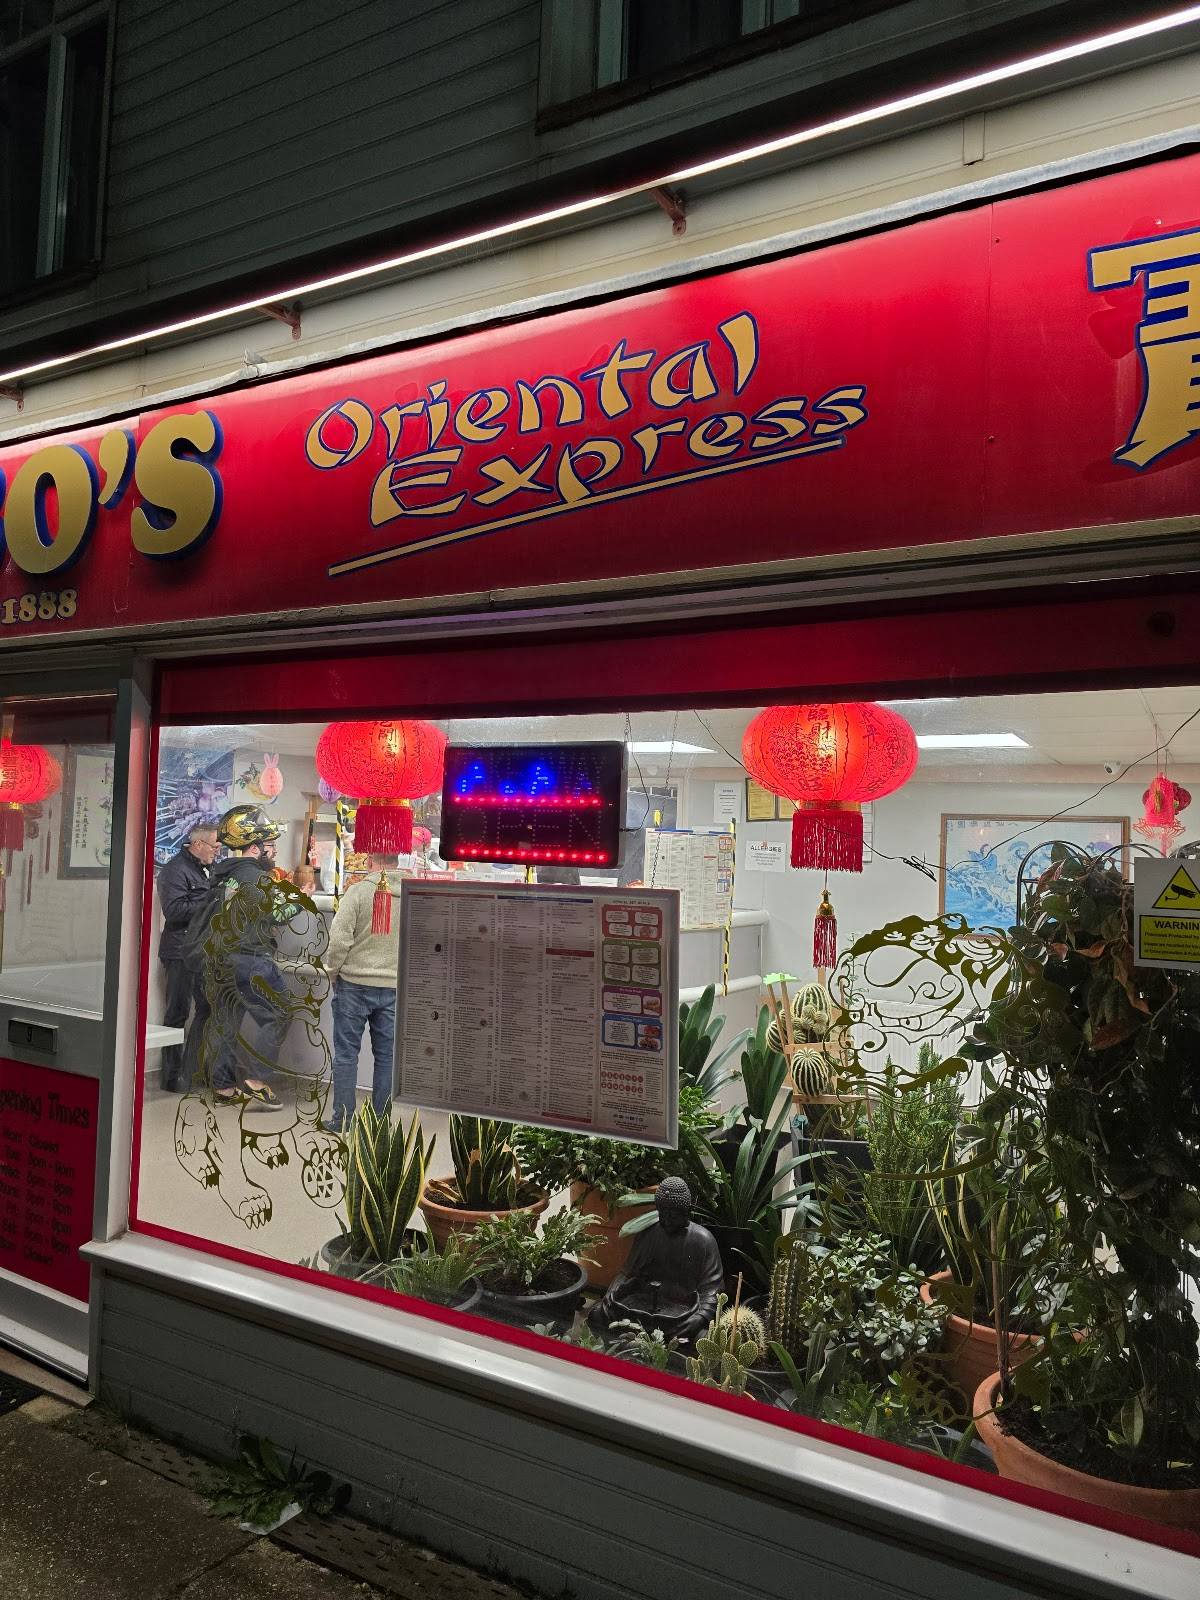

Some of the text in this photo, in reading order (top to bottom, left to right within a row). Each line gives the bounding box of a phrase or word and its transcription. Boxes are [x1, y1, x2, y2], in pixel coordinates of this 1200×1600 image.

[305, 311, 760, 469] Oriental
[0, 410, 224, 575] O'S
[369, 385, 869, 528] Express
[1, 588, 78, 625] 1888
[1154, 920, 1200, 931] WARNIN
[0, 1088, 90, 1129] pening Times
